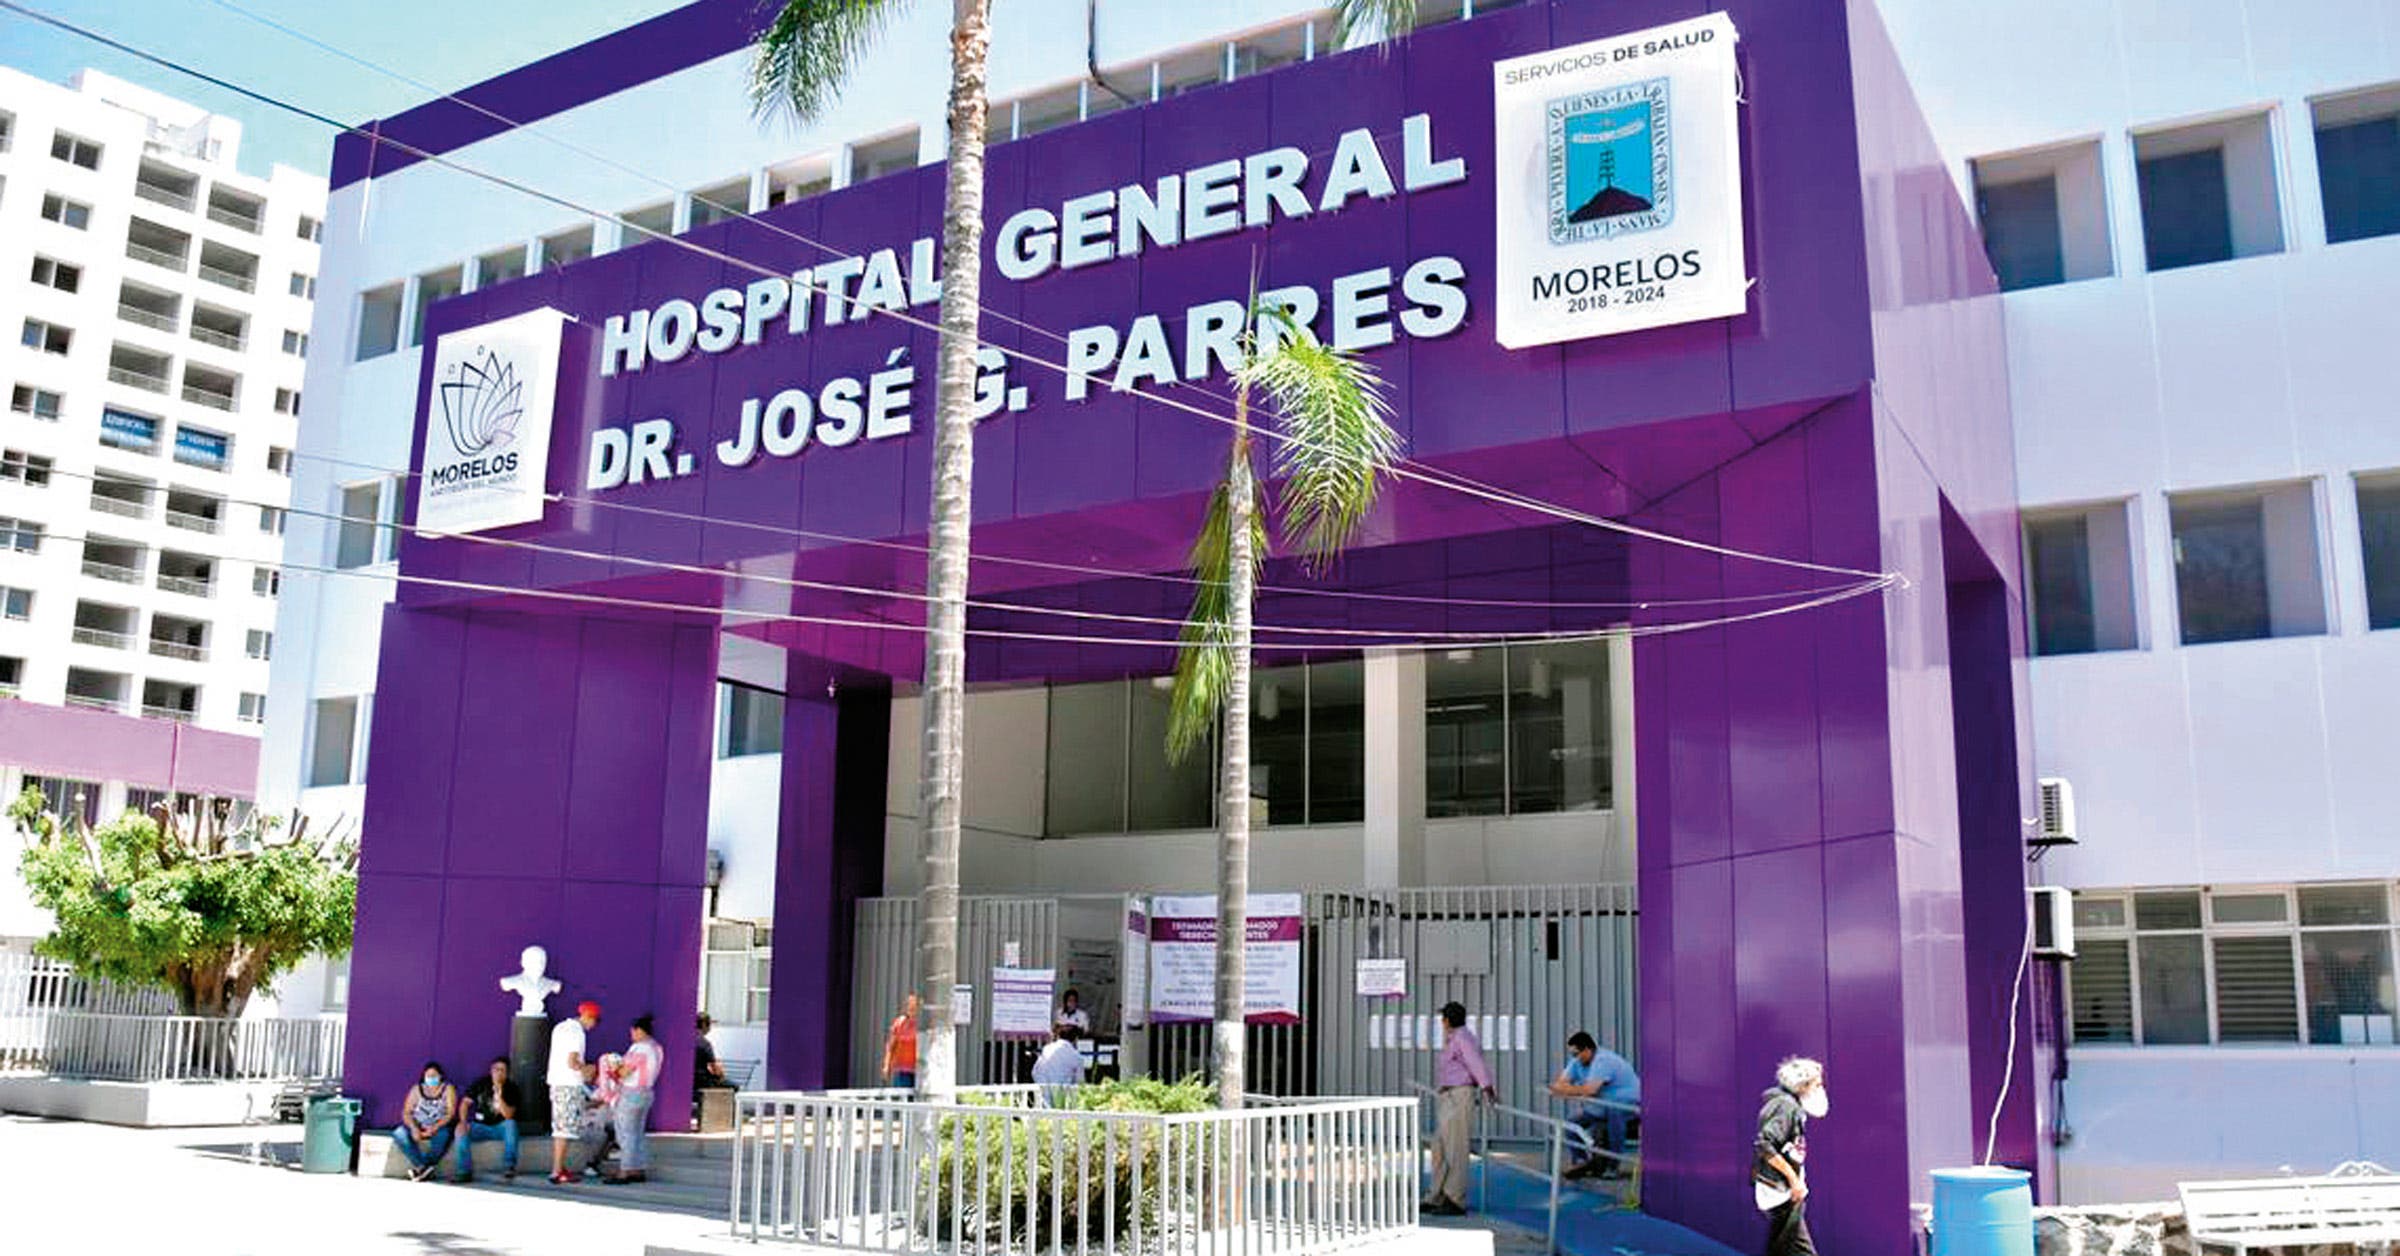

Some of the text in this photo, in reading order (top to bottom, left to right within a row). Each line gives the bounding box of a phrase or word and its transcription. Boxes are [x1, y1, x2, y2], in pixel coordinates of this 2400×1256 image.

[1504, 28, 1715, 85] SERVICIOS DE SALUD
[600, 113, 1466, 377] HOSPITAL GENERAL
[1532, 250, 1701, 300] MORELOS
[1567, 293, 1607, 313] 2018
[1624, 285, 1665, 304] 2024
[587, 418, 694, 490] DR.
[716, 347, 915, 469] JOSÉ
[1065, 256, 1469, 402] PARRES
[430, 451, 518, 487] MORELOS
